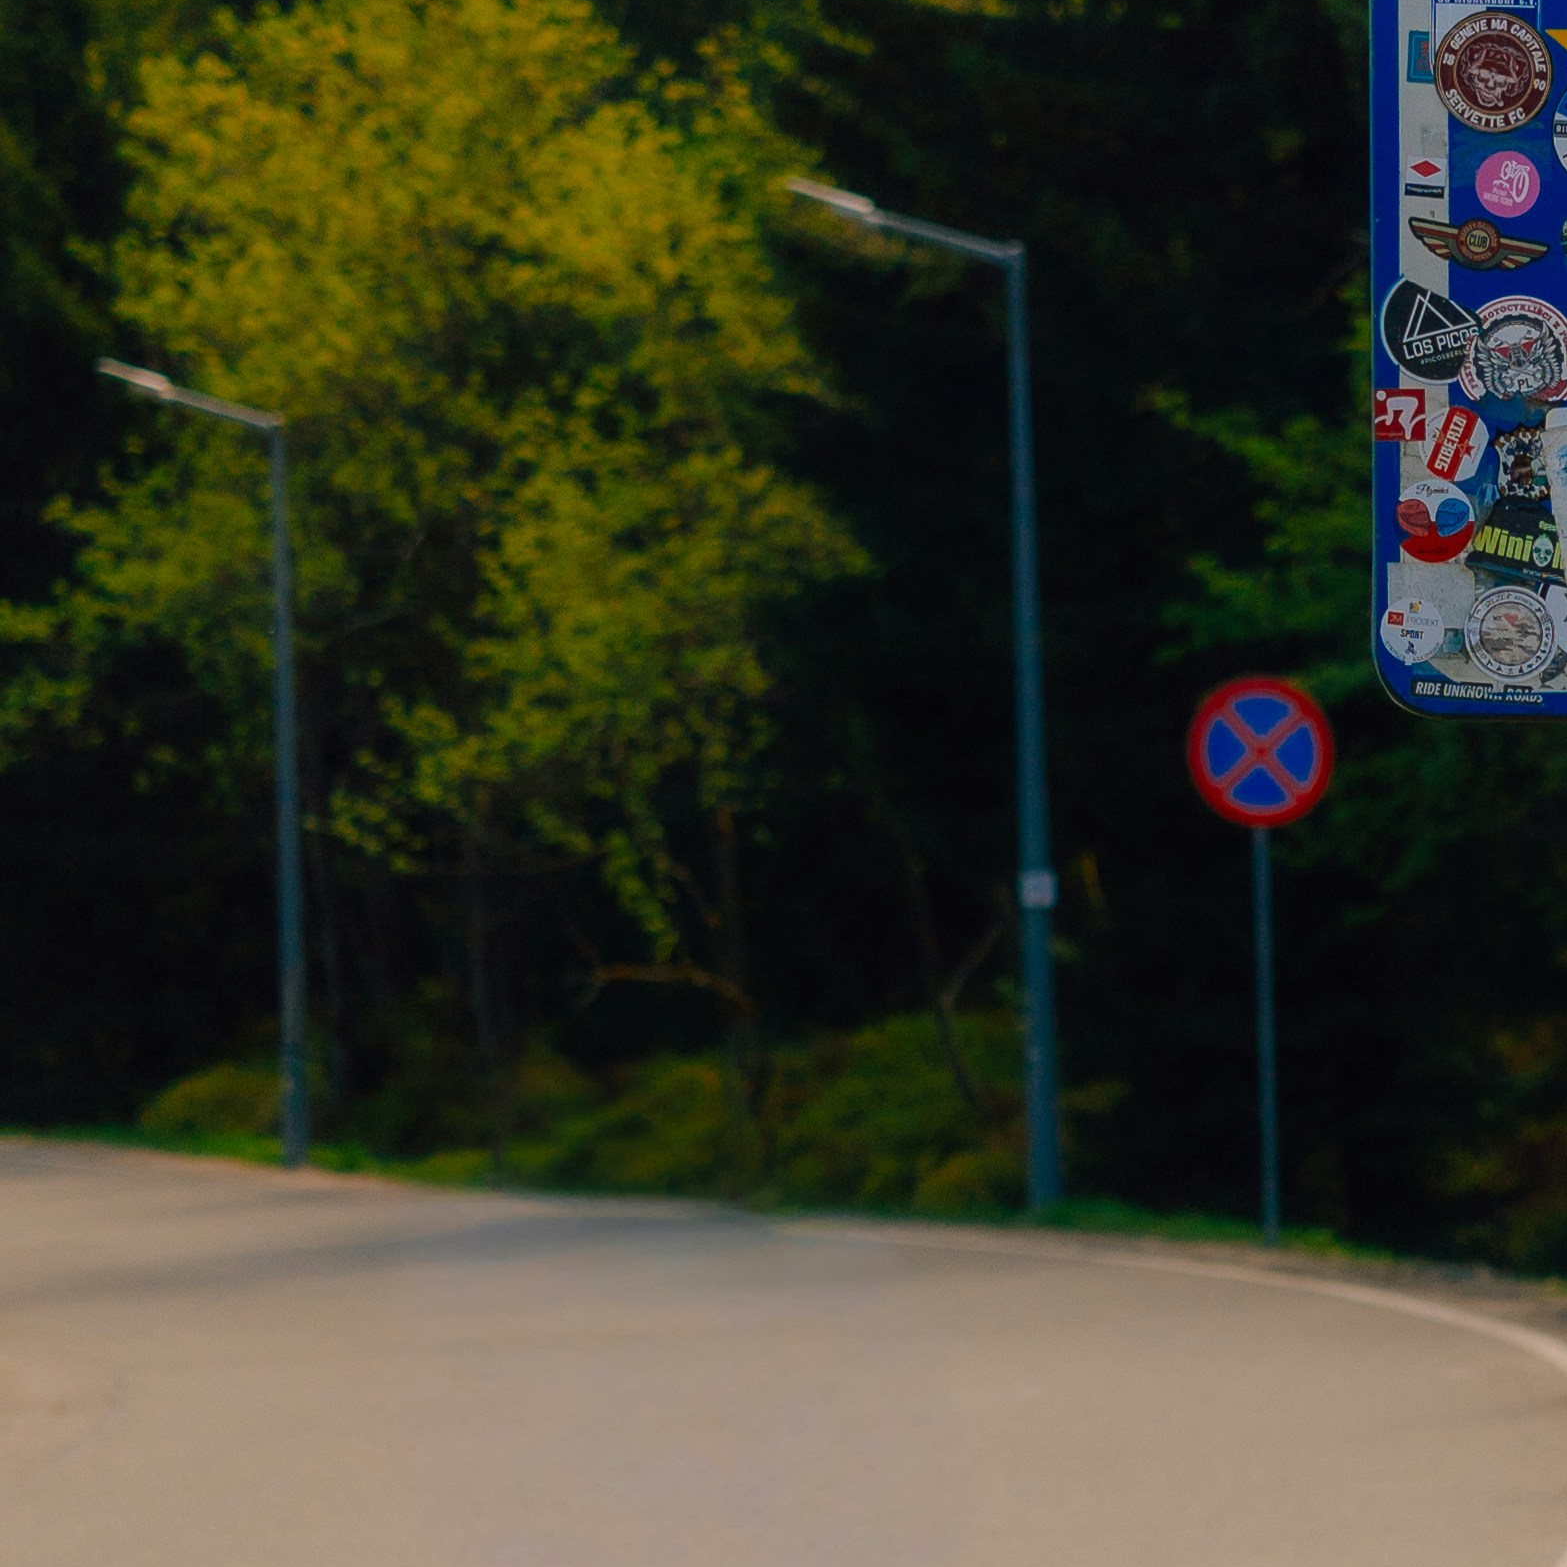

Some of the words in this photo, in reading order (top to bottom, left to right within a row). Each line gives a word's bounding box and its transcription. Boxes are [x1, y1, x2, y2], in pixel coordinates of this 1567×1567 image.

[1491, 18, 1509, 32] MA
[1510, 22, 1547, 73] CAPITALE
[1445, 88, 1506, 128] SERVETTE
[1507, 107, 1526, 125] FC
[1469, 234, 1488, 247] CLUB
[1403, 339, 1433, 360] LOS
[1436, 325, 1481, 351] PICOS
[1518, 378, 1533, 390] PL
[1434, 414, 1467, 472] SIBERIA
[1475, 526, 1533, 562] Wini
[1399, 628, 1424, 640] SPORT
[1415, 681, 1441, 697] RIDE
